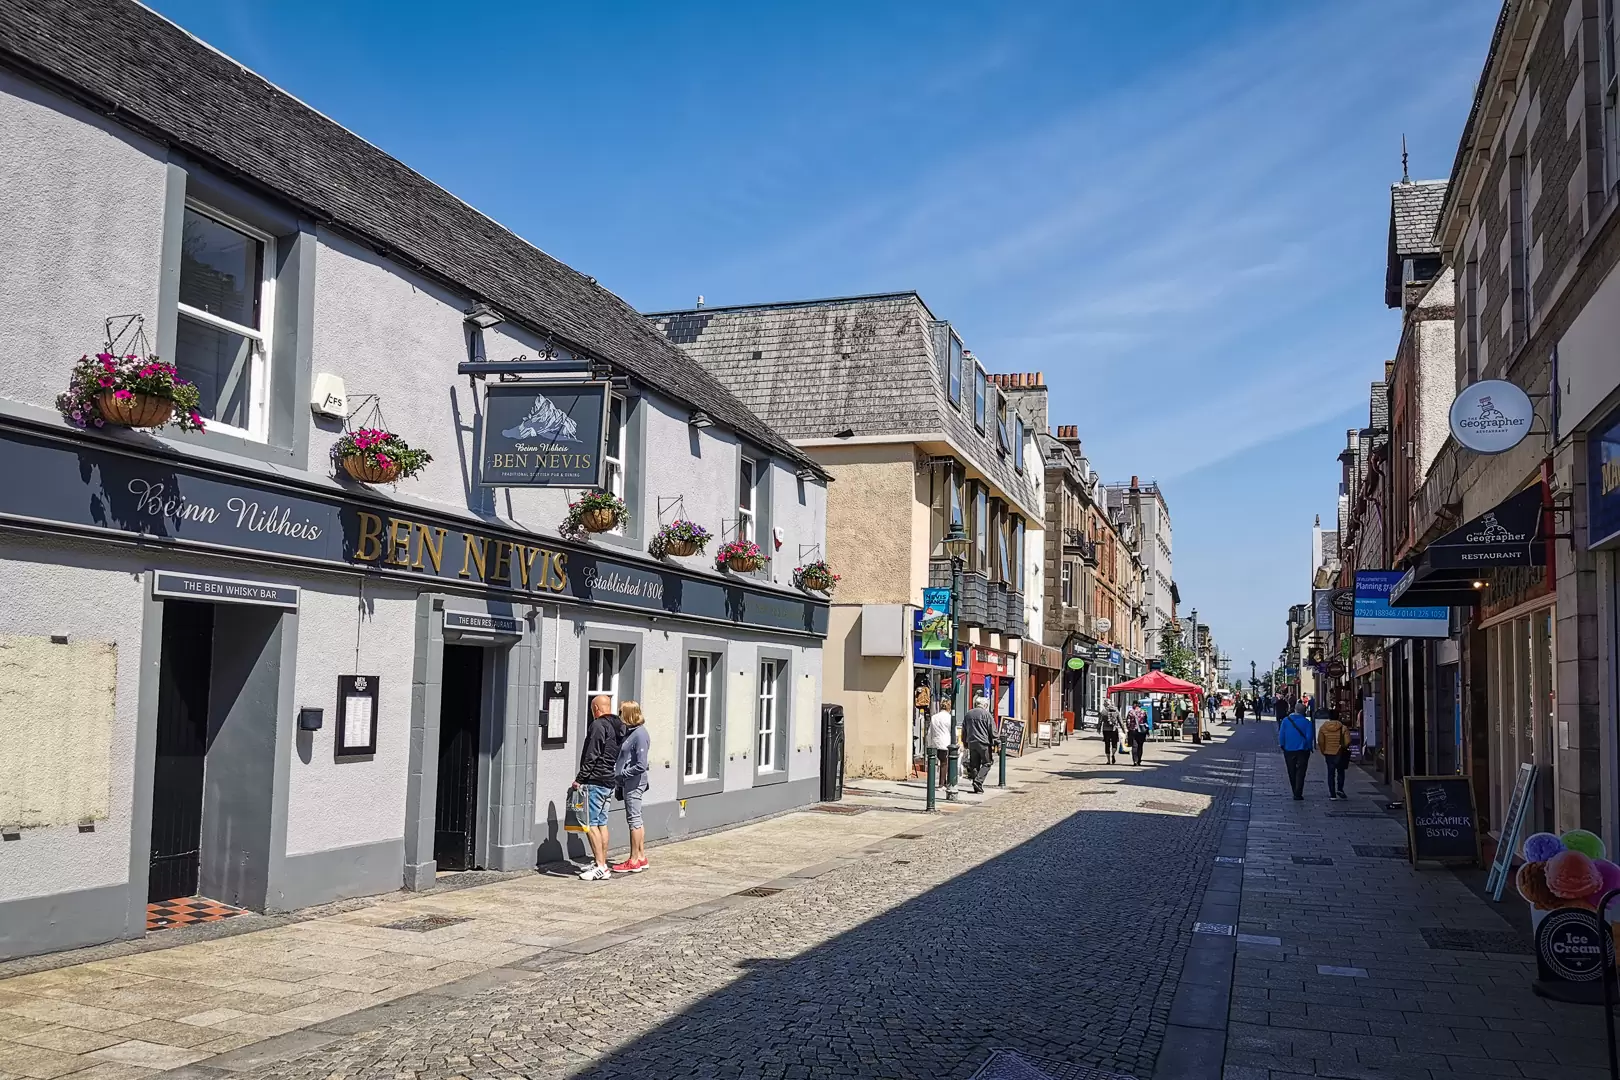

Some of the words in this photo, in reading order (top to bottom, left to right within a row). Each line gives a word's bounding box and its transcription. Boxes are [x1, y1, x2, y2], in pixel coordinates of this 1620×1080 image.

[1459, 417, 1525, 430] Geographer
[514, 442, 539, 452] Beinn
[492, 453, 529, 468] BEN
[534, 453, 592, 469] NEVIS
[127, 478, 221, 524] Beinn
[226, 497, 323, 541] Nibheis
[1466, 532, 1526, 544] Geographer
[354, 511, 448, 574] BEN
[458, 533, 568, 592] NEVIS
[1461, 551, 1522, 560] RESTAURANT
[582, 566, 641, 596] Established
[1356, 582, 1383, 592] Planning
[183, 580, 202, 592] THE
[204, 582, 223, 594] BEN
[225, 585, 259, 598] WHISKY
[260, 588, 277, 600] BAR
[1355, 608, 1374, 616] 07920
[459, 616, 469, 625] THE
[470, 617, 481, 626] BEN
[1415, 816, 1471, 827] GEOGRAPHER
[1426, 827, 1459, 838] BISTRO
[1565, 932, 1589, 944] Ice
[1553, 942, 1601, 954] Cream
